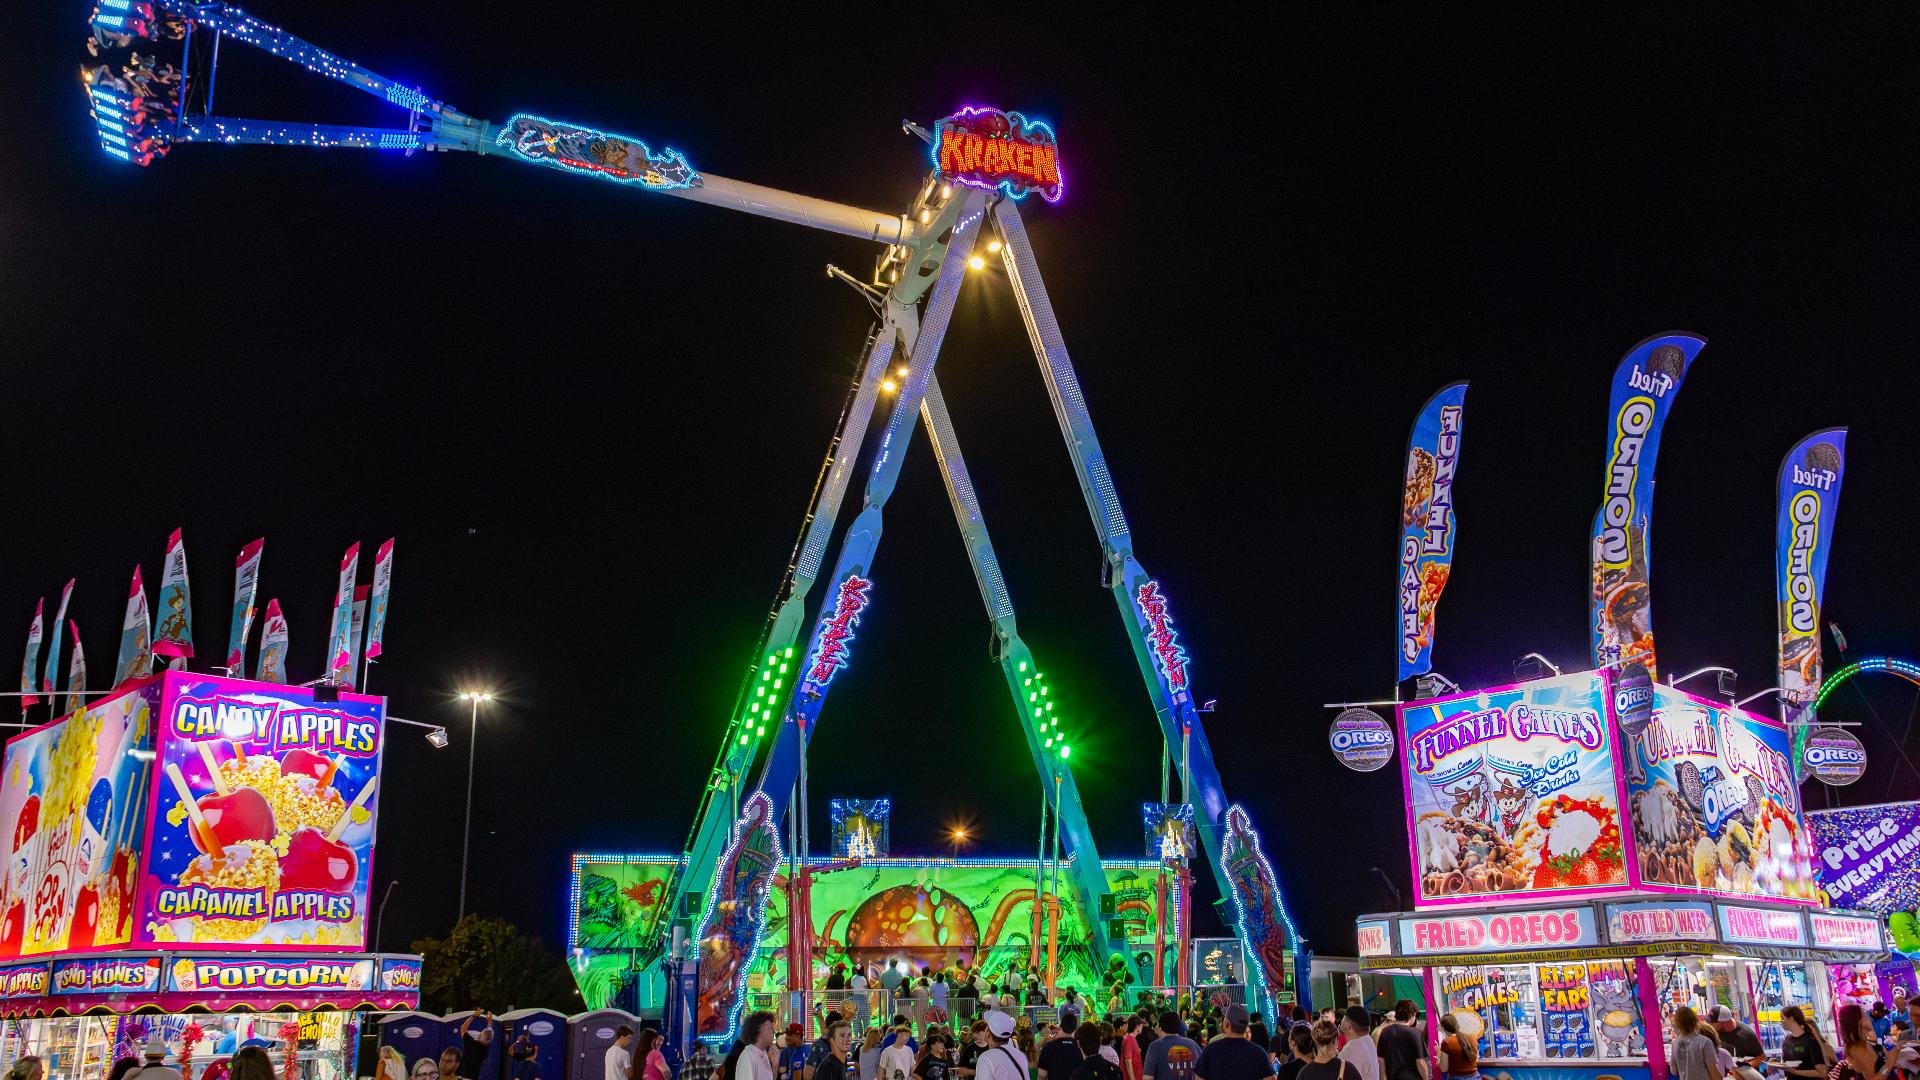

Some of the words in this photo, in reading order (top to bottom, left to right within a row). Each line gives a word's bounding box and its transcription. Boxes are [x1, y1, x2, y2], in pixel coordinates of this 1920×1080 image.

[940, 131, 1059, 184] KRAKEN
[811, 577, 866, 682] KRAKEN
[1139, 583, 1187, 686] KRAKEN
[1617, 688, 1653, 711] OREOS
[177, 703, 273, 741] CANDY
[281, 713, 376, 752] APPLES
[1334, 731, 1391, 748] OREOS
[1418, 714, 1506, 770] FUNNEL
[1510, 705, 1600, 747] CAKES
[1520, 767, 1545, 785] Ice
[1546, 751, 1578, 774] Cold
[1808, 749, 1864, 763] OREOS
[1532, 771, 1580, 797] Drinks
[1822, 818, 1899, 870] Prize
[158, 888, 267, 917] CARAMEL
[275, 893, 352, 920] APPLES
[1414, 919, 1485, 950] FRIED
[1490, 910, 1581, 944] OREOS
[1622, 911, 1673, 934] BOTTLED
[1677, 911, 1706, 933] WATER
[1727, 909, 1767, 938] FUNNEL
[9, 971, 43, 994] APPLES
[62, 966, 144, 986] SNO-KONES
[198, 964, 352, 987] POPCORN
[1463, 981, 1519, 1011] CAKES
[1544, 986, 1589, 1011] EARS
